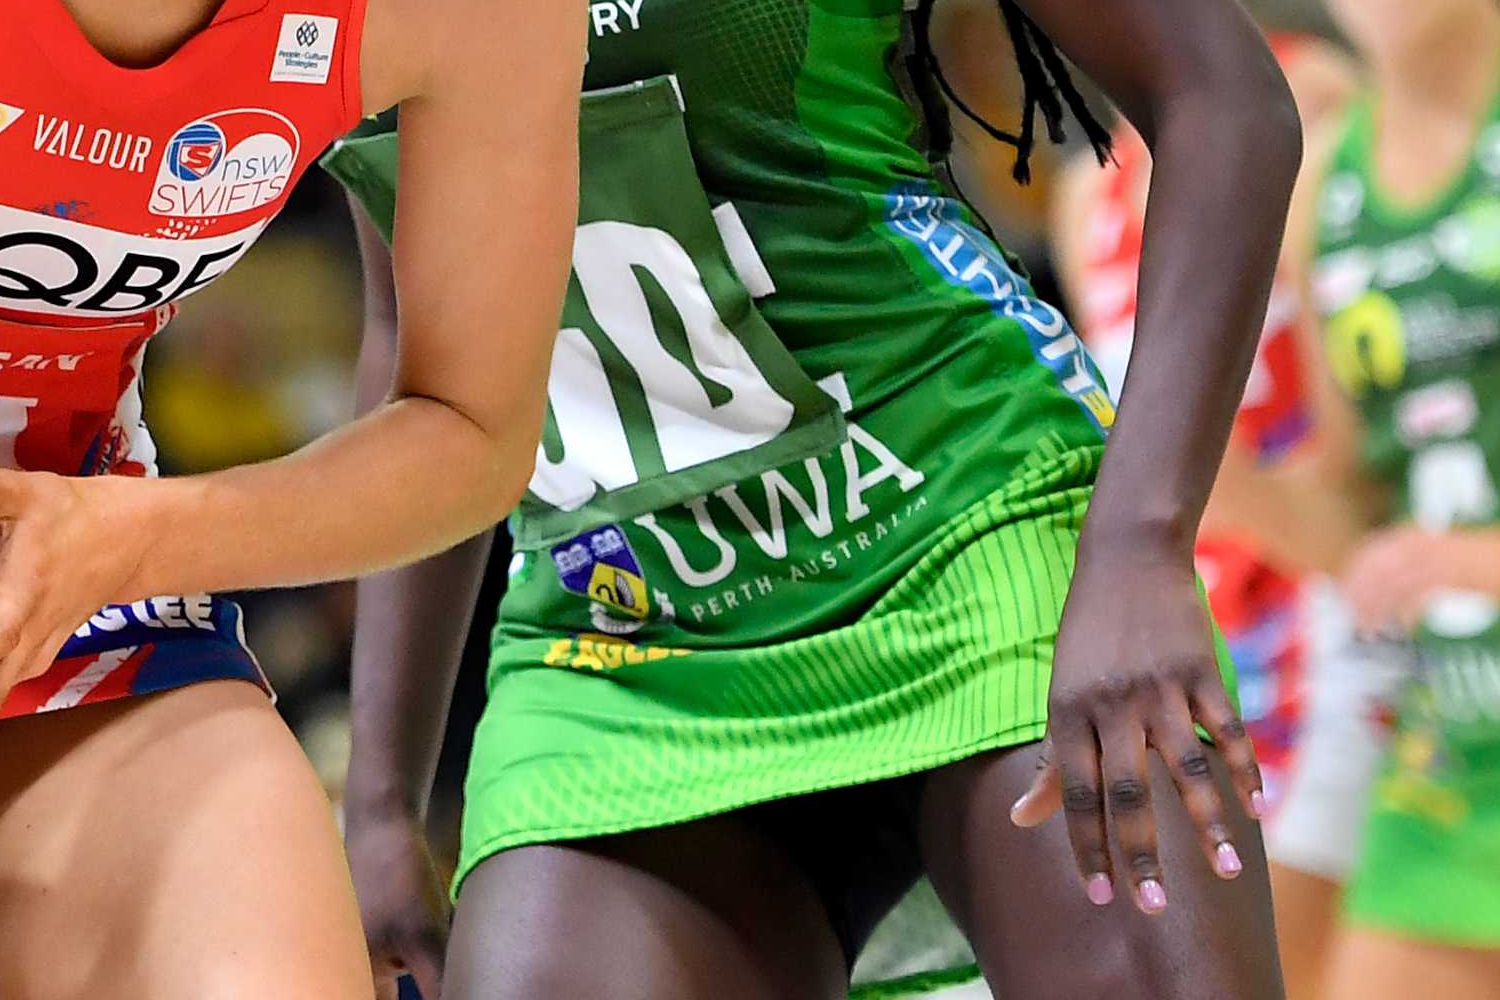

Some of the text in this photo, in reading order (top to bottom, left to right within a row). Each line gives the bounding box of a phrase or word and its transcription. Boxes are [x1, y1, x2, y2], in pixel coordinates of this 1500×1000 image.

[34, 114, 152, 173] VALOUR
[221, 153, 288, 182] nsw
[152, 175, 286, 214] SWIFTS
[633, 422, 925, 588] UWA
[690, 574, 773, 622] PERTH
